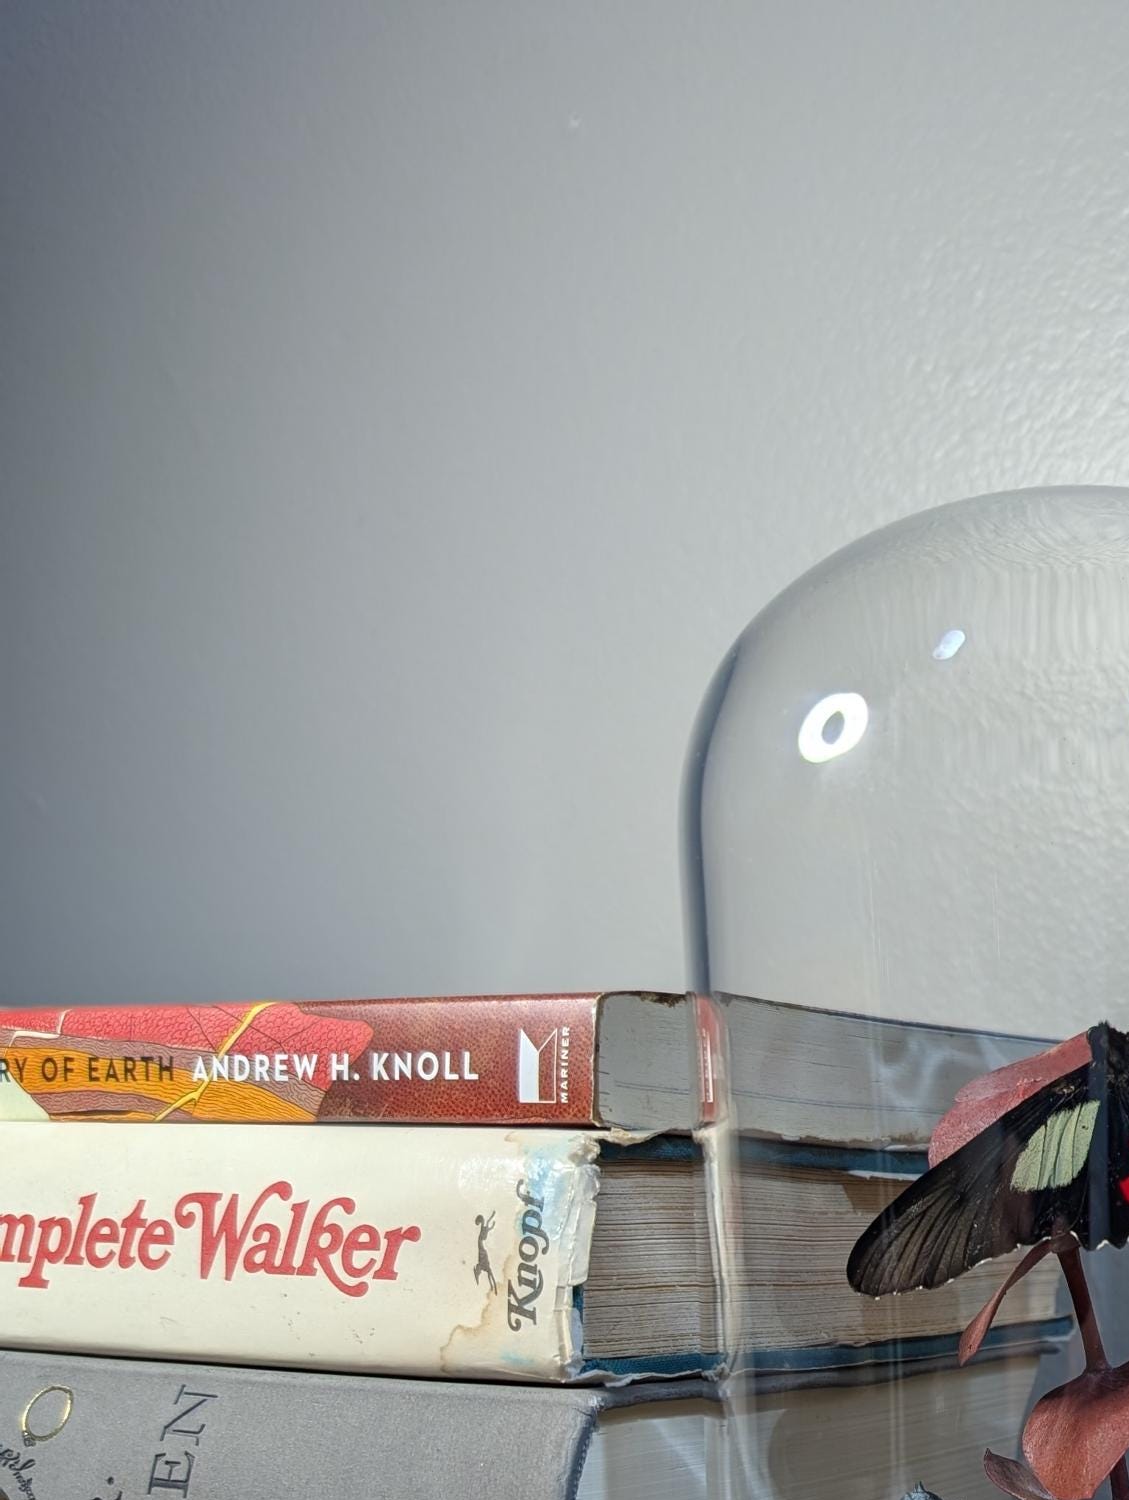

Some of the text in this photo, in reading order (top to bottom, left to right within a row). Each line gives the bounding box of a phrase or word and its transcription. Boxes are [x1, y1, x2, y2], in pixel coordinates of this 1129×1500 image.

[41, 1056, 75, 1082] OF
[88, 1055, 174, 1082] EARTH
[192, 1052, 318, 1082] ANDREW
[331, 1053, 360, 1081] H.
[372, 1050, 479, 1081] KNOLL
[561, 1026, 571, 1104] MARINER
[174, 1181, 421, 1297] Walker
[507, 1179, 549, 1332] Knopf
